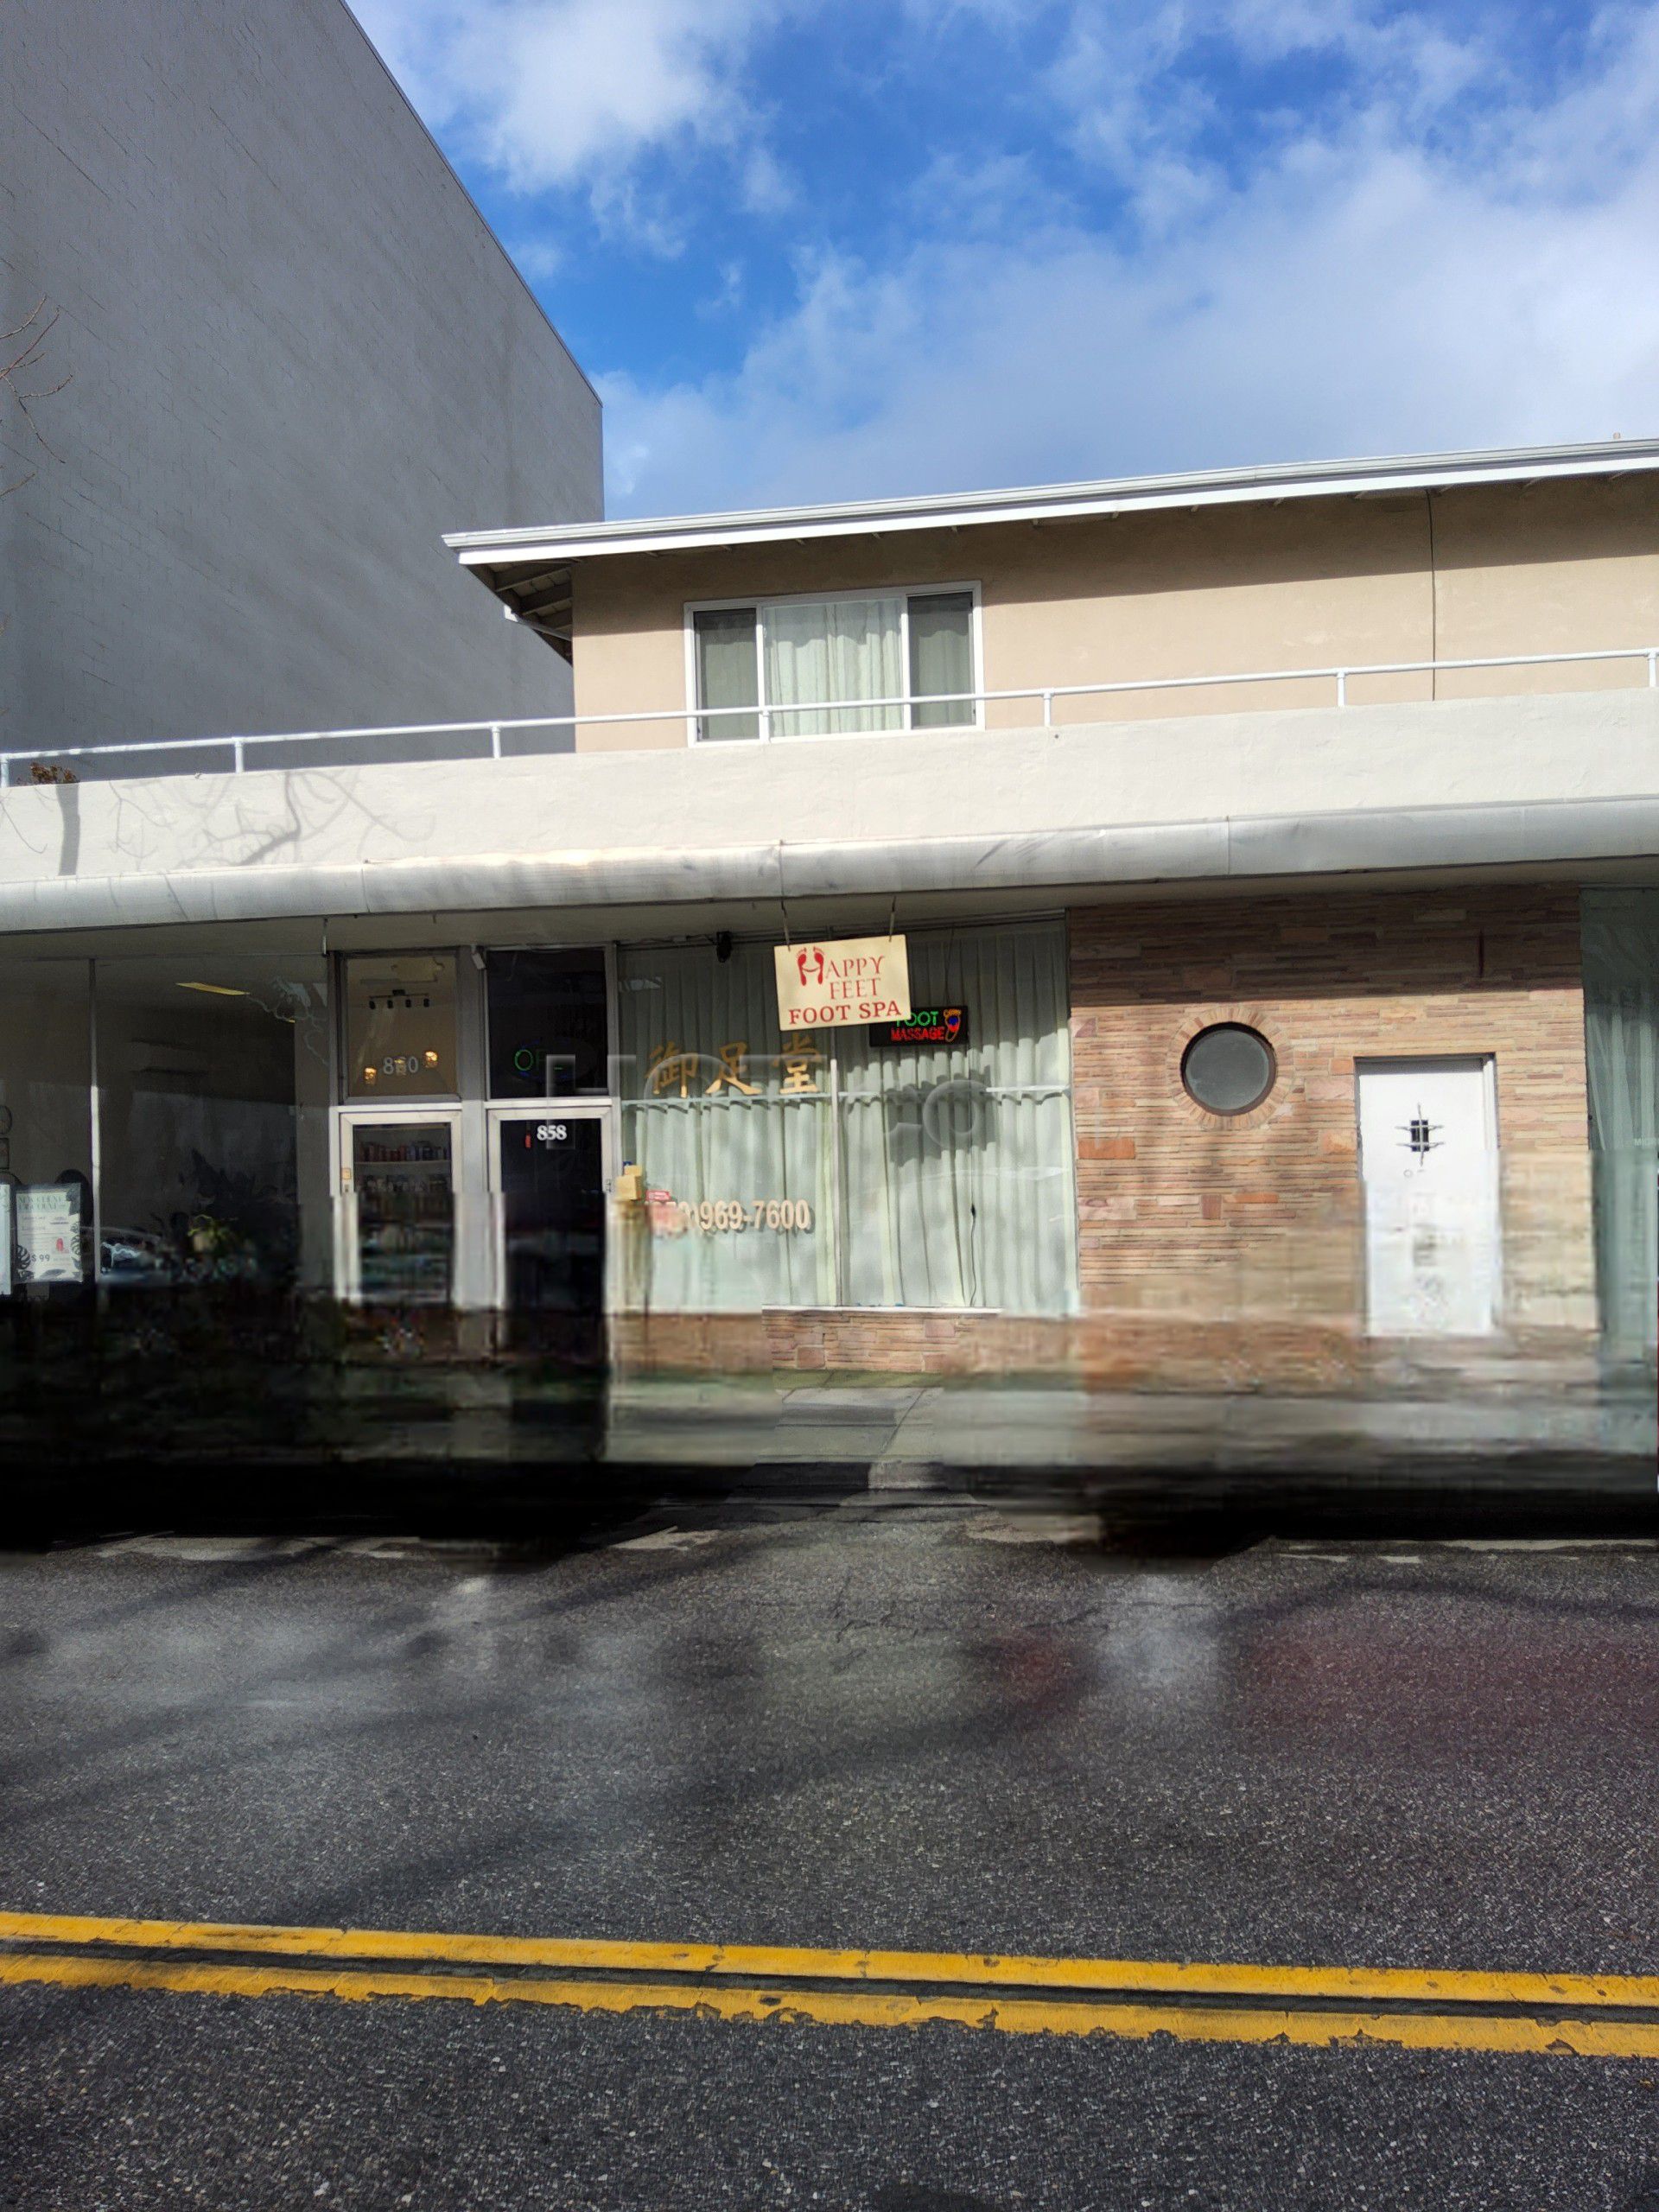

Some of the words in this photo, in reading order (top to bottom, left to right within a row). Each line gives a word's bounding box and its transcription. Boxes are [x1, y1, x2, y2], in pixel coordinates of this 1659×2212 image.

[797, 947, 885, 987] HAPPY
[830, 977, 881, 1000] FEET
[788, 1004, 851, 1025] FOOT
[858, 1000, 901, 1020] SPA
[890, 1026, 945, 1041] MASSAGE
[537, 1124, 567, 1141] 858
